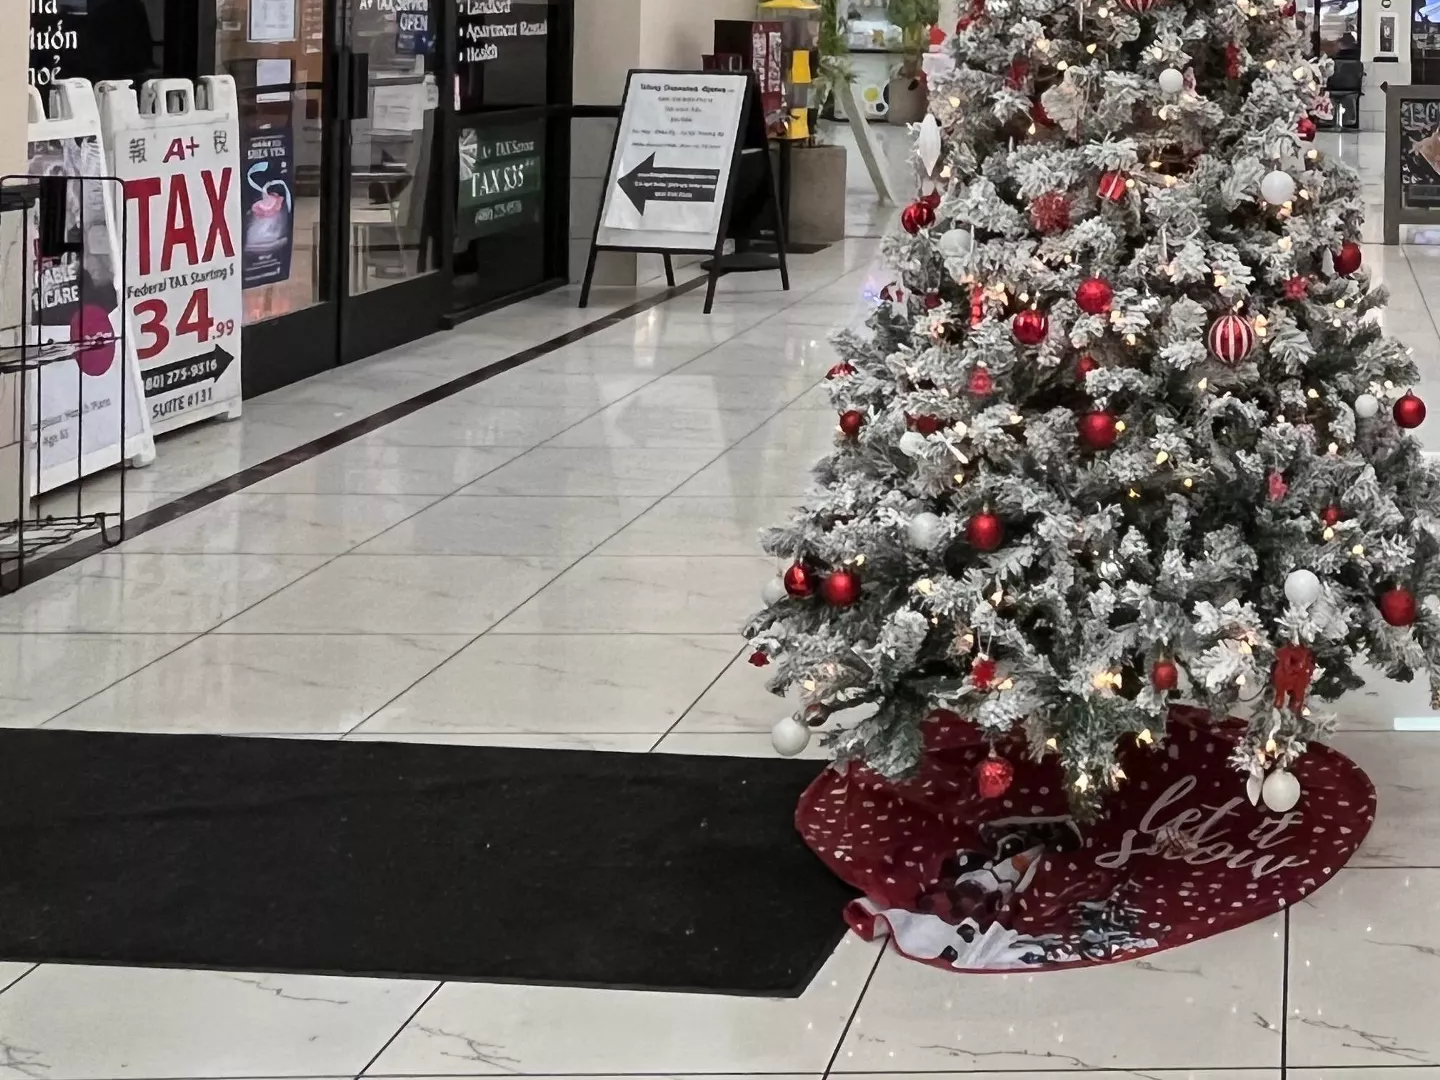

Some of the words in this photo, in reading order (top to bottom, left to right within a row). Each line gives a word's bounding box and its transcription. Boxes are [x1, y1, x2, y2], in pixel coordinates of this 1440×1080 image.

[399, 12, 429, 32] OPEN
[162, 136, 200, 163] A+
[124, 167, 235, 276] TAX
[168, 274, 188, 290] TAX
[152, 395, 185, 420] SUITE
[1139, 775, 1244, 842] let
[1247, 807, 1304, 848] it
